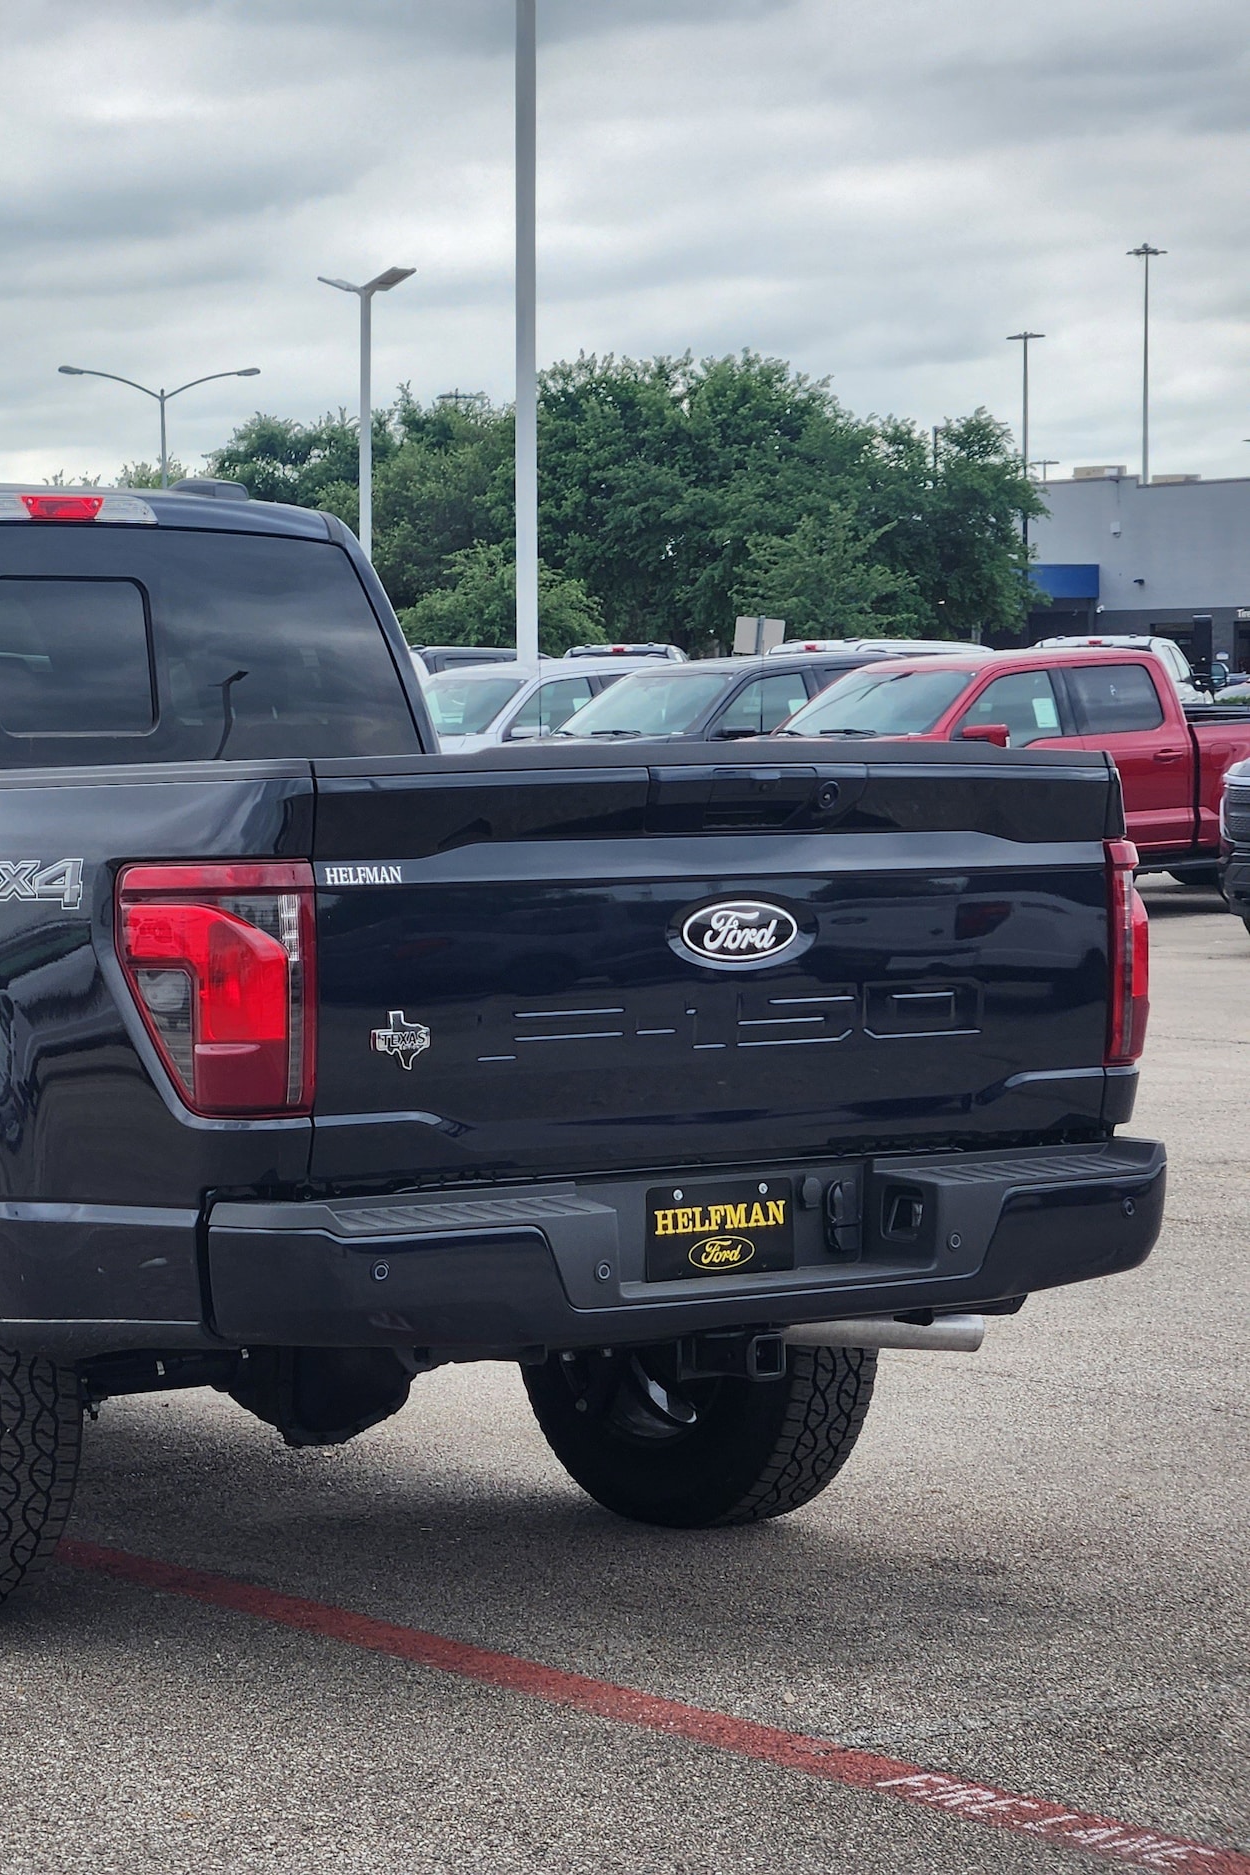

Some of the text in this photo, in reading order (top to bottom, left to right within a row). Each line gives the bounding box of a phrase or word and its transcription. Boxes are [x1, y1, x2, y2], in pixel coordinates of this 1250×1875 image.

[325, 865, 403, 885] HELFMAN
[703, 910, 778, 950] Ford
[381, 1031, 426, 1046] TEXAS
[653, 1199, 786, 1236] HELFMAN
[701, 1240, 742, 1265] Ford
